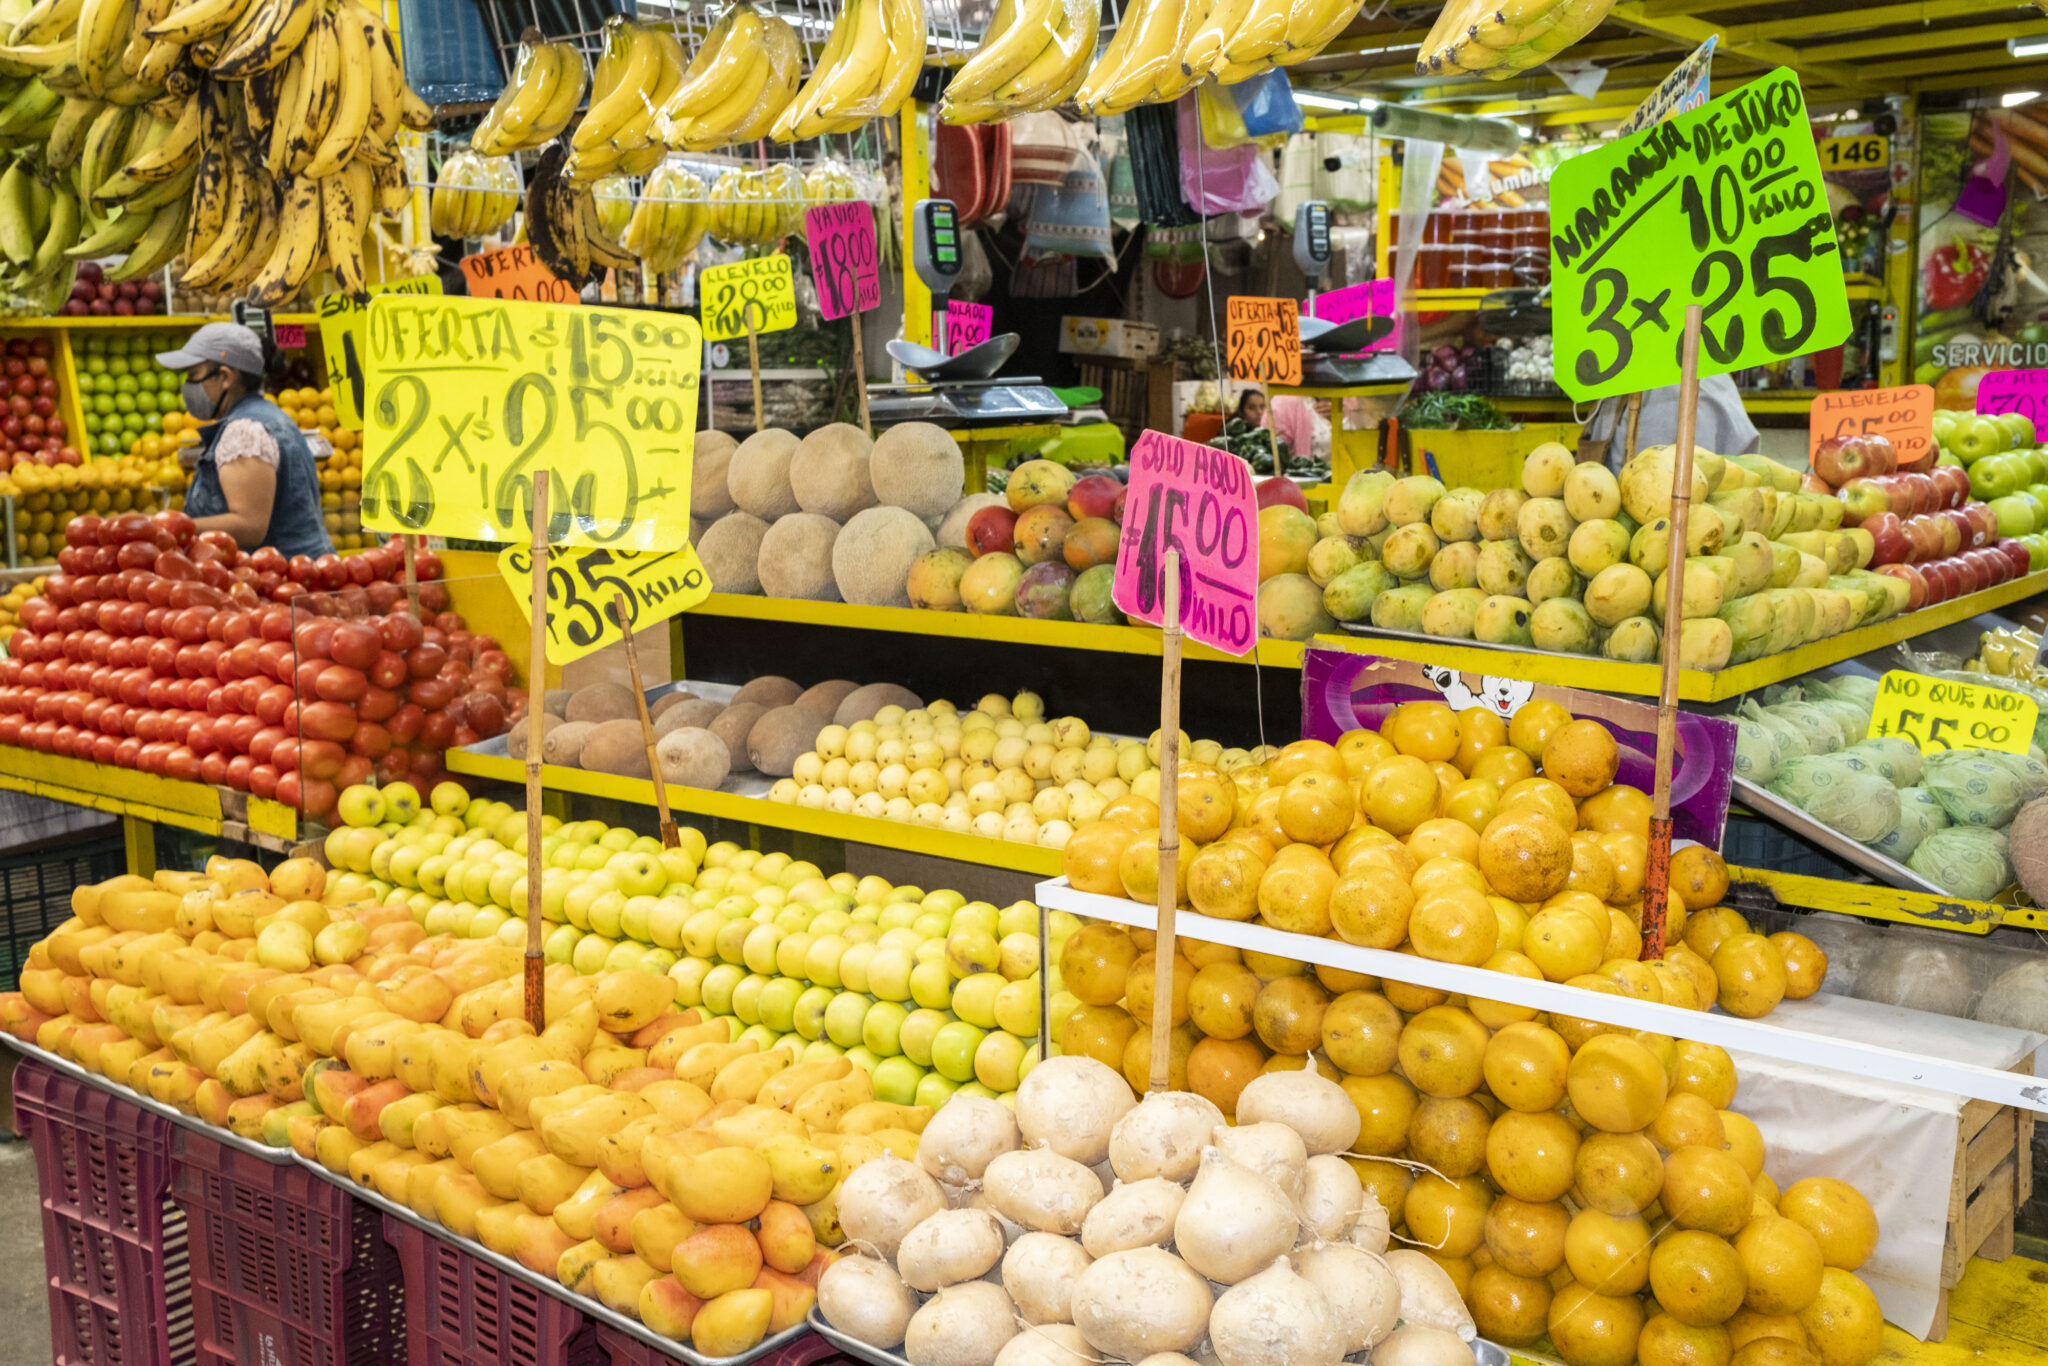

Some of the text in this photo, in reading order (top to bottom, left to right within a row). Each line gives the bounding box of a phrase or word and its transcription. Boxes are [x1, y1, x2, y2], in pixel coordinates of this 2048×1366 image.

[1826, 139, 1882, 166] 146
[1551, 119, 1692, 268] NARANJA
[1692, 112, 1733, 165] DE
[1725, 80, 1801, 145] JUGO
[1749, 180, 1816, 225] KILO
[811, 206, 833, 232] YA
[471, 246, 536, 279] OFERT
[706, 258, 789, 284] LLEVELO
[765, 301, 794, 320] KILO
[948, 303, 985, 322] ULADA
[1230, 300, 1274, 320] OFERTA
[370, 302, 524, 363] OFERTA
[1931, 343, 2048, 367] SERVICIO
[633, 368, 699, 389] KILO
[1824, 389, 1920, 412] LLEVELO
[1141, 431, 1248, 500] SOLO AQUI
[637, 568, 704, 608] KILO
[1191, 590, 1251, 648] KILO
[1883, 675, 1921, 697] NO
[1928, 683, 1975, 709] QUE
